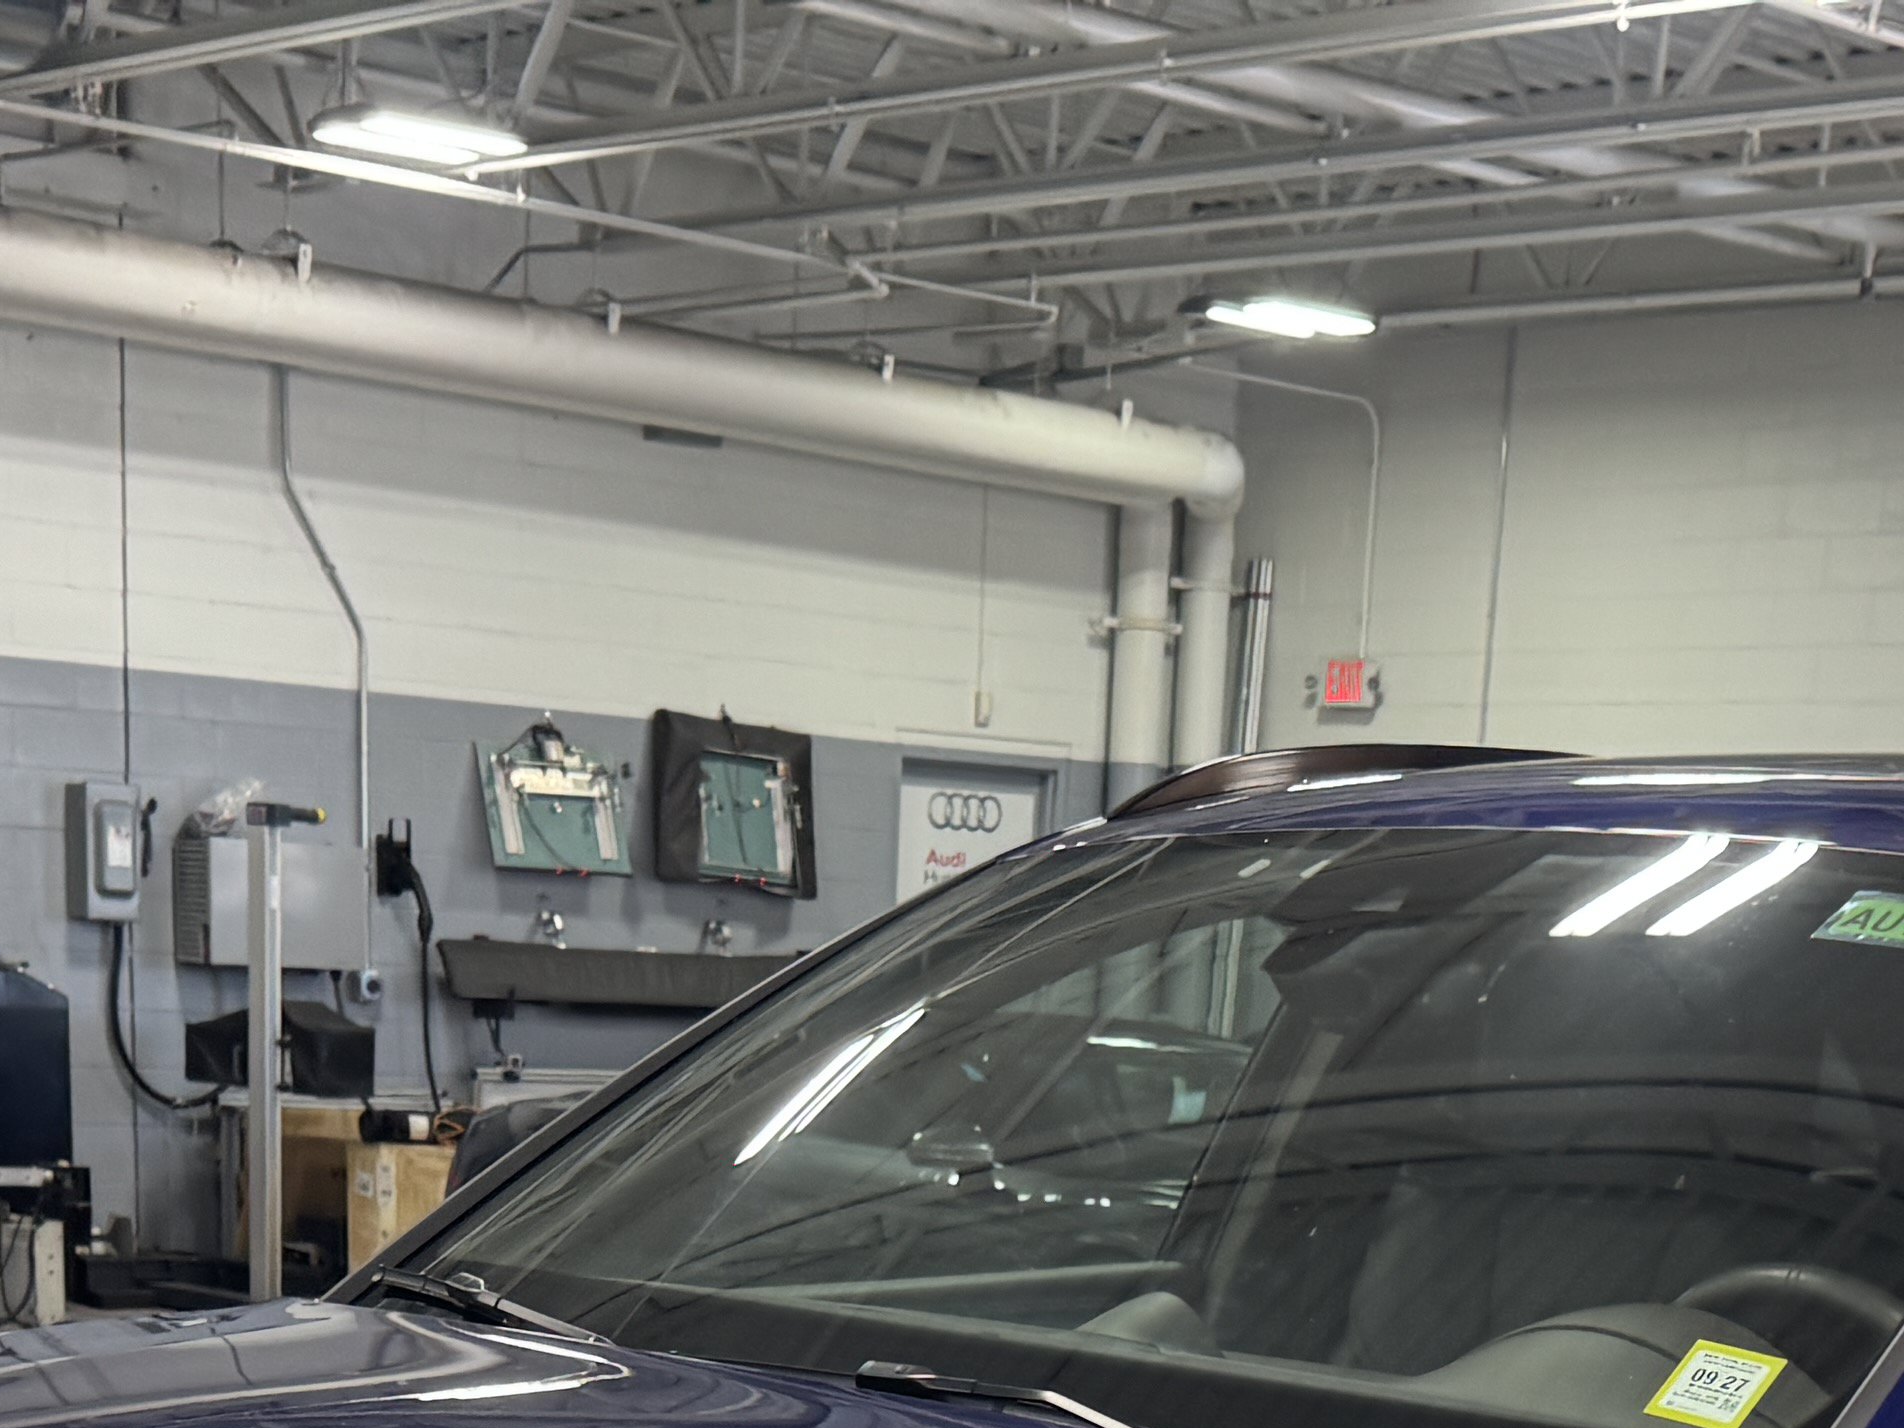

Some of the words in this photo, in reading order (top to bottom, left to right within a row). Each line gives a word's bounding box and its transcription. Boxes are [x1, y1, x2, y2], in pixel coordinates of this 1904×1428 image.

[925, 849, 966, 868] Audi
[1691, 1368, 1719, 1385] 09
[1720, 1376, 1751, 1392] 27
